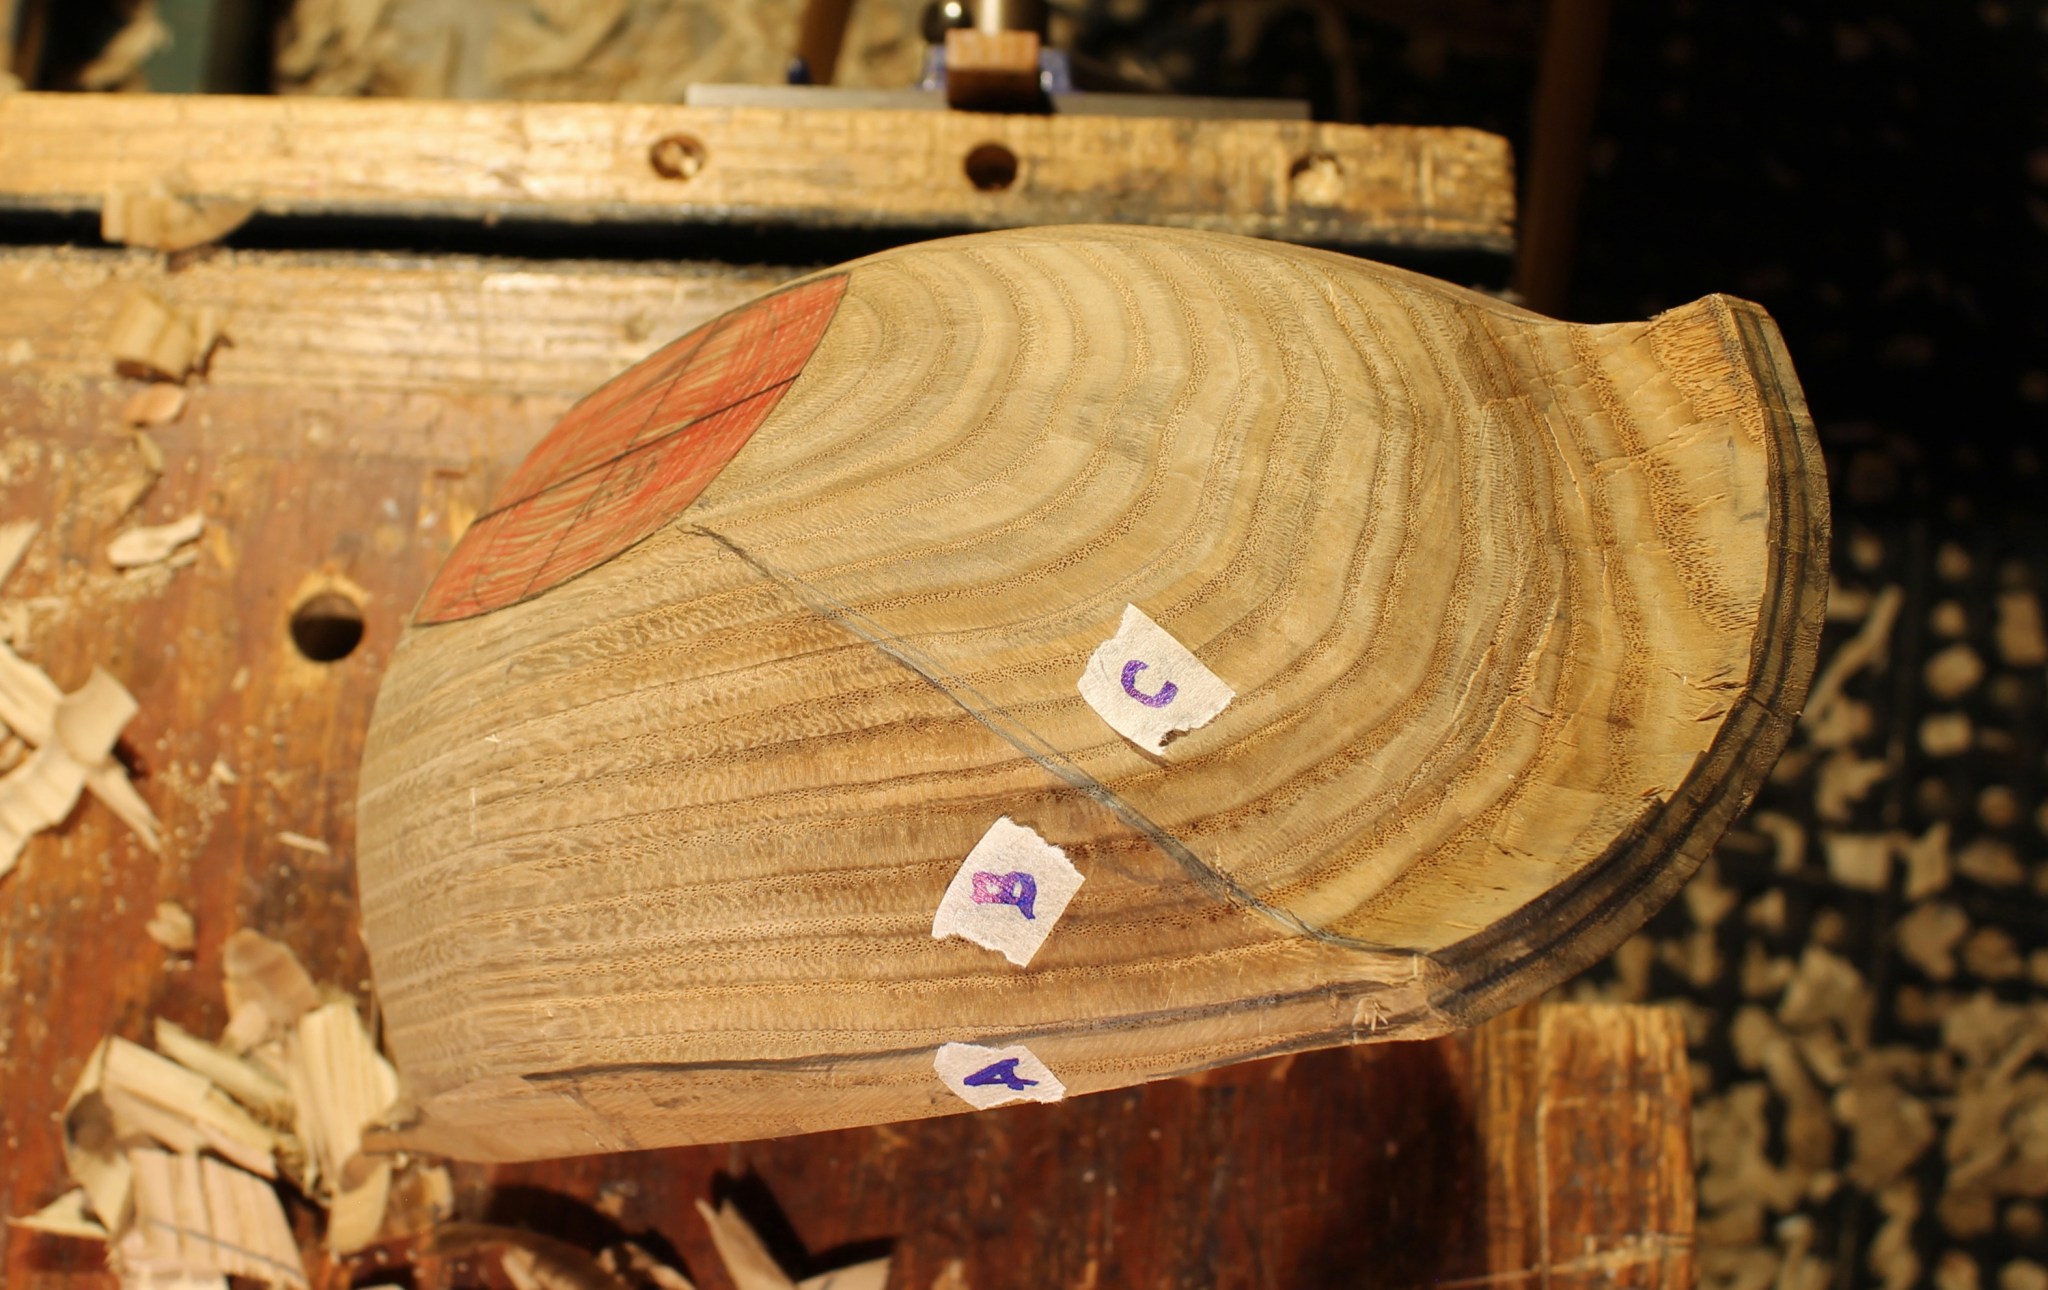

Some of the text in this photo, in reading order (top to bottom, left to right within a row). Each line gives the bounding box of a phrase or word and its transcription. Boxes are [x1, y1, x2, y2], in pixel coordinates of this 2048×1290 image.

[1120, 660, 1178, 708] C
[970, 870, 1037, 920] B
[963, 1058, 1038, 1091] A
